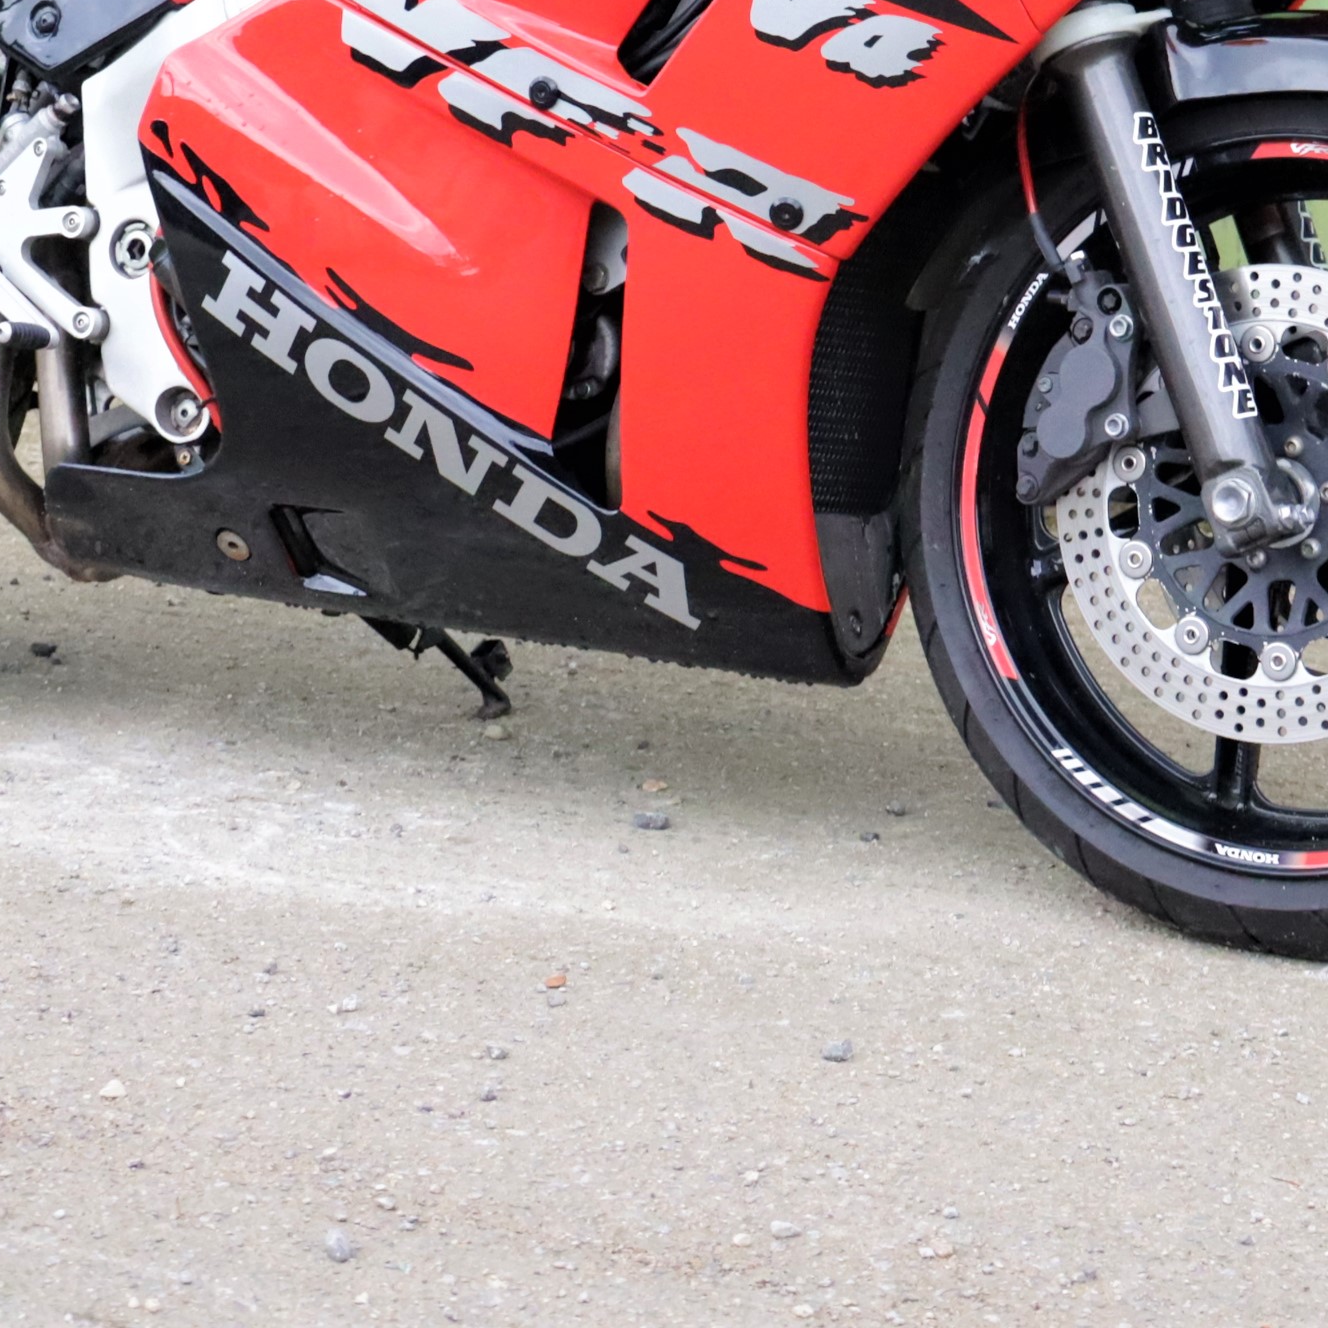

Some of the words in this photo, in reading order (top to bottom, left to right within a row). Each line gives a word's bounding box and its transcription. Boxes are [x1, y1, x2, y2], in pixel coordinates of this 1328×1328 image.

[1007, 273, 1049, 330] HONDA
[1133, 112, 1258, 418] BRIDGESTONE
[201, 250, 701, 631] HONDA
[1215, 843, 1280, 865] HONDA
